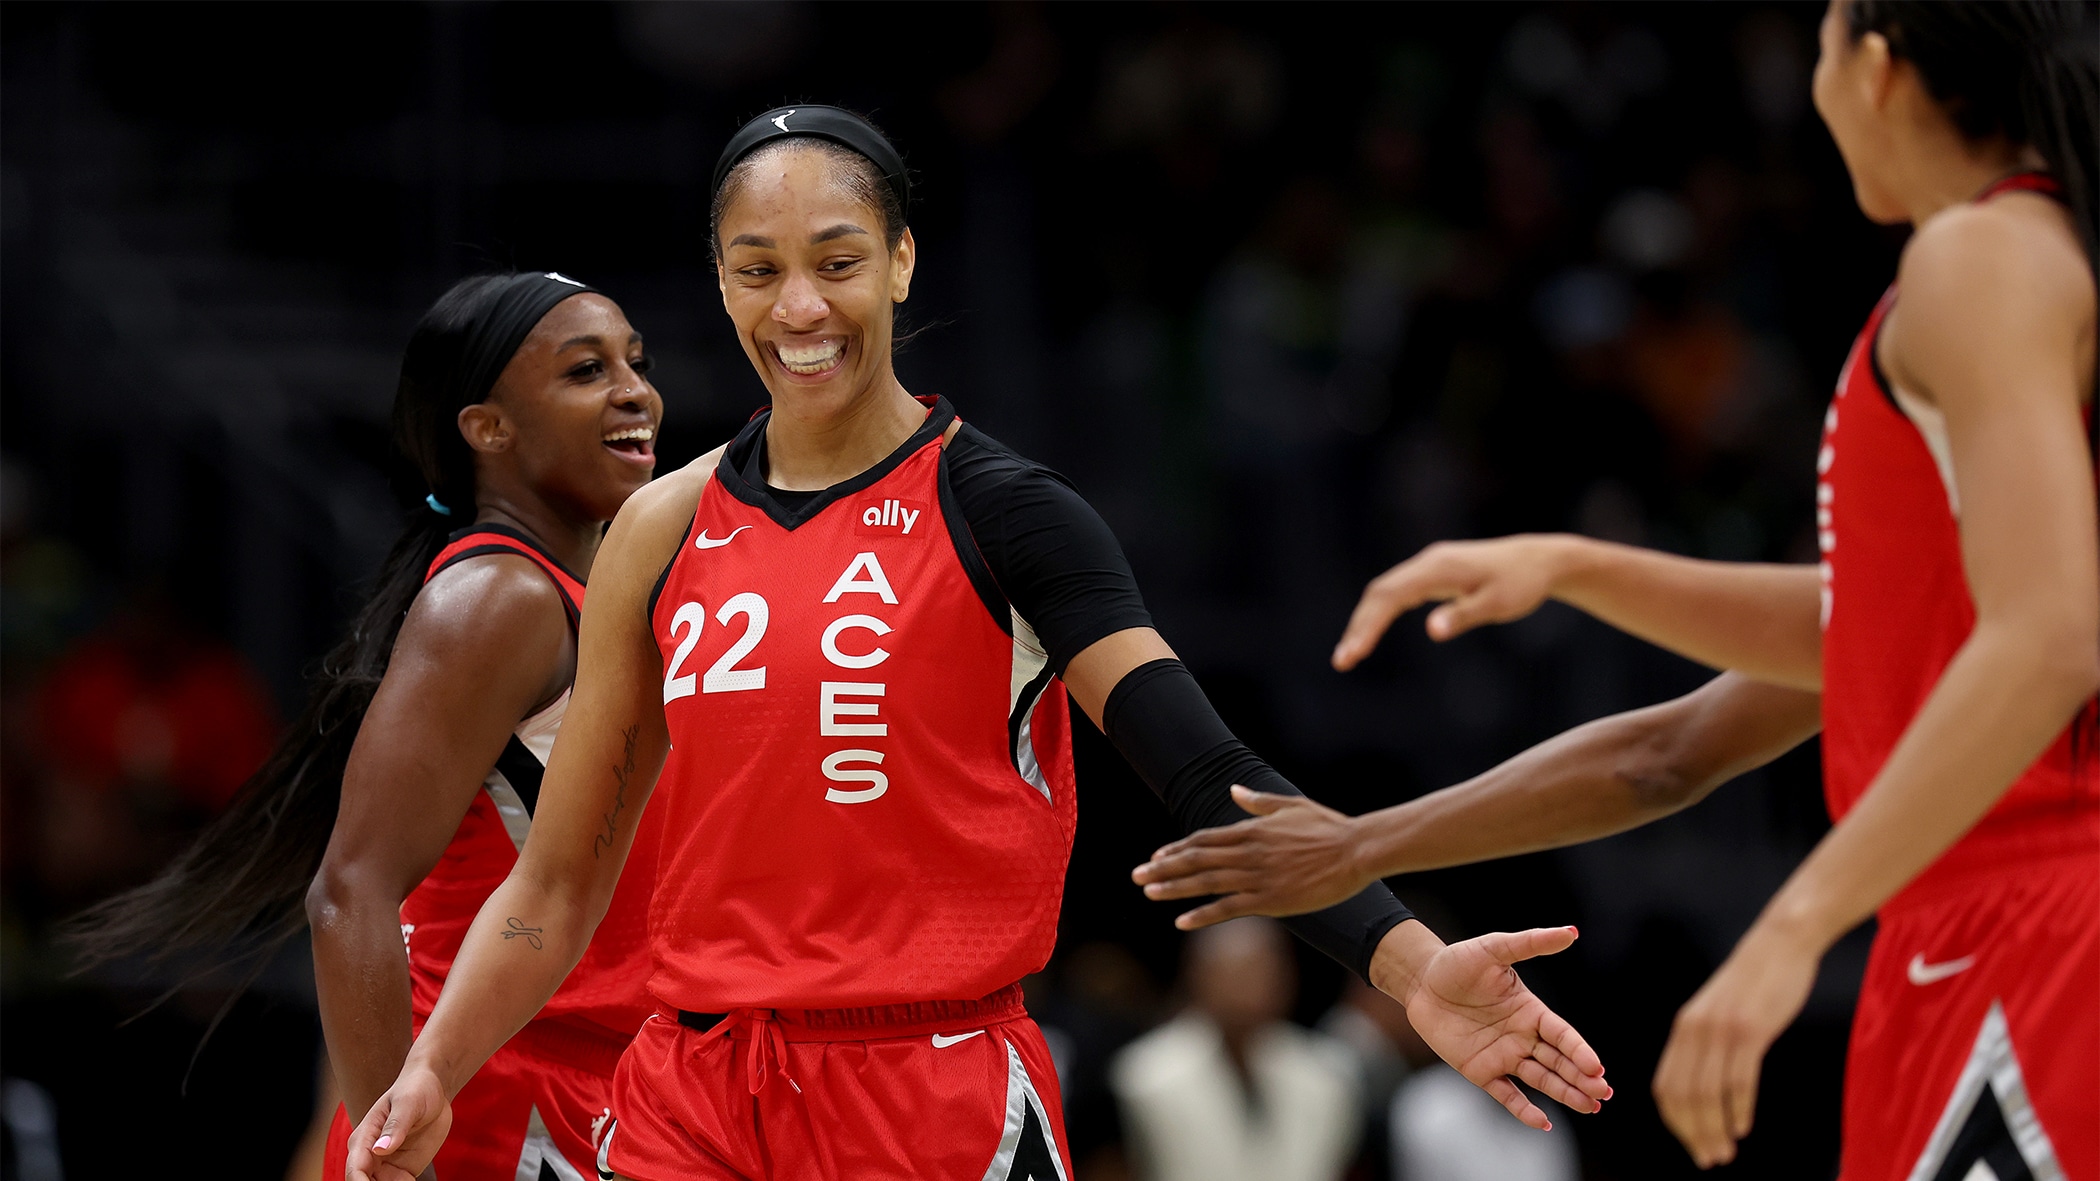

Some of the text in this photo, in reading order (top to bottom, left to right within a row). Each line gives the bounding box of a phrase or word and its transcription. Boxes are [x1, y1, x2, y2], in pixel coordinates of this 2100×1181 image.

[863, 500, 920, 534] ally
[664, 592, 769, 705] 22
[820, 552, 899, 804] ACES
